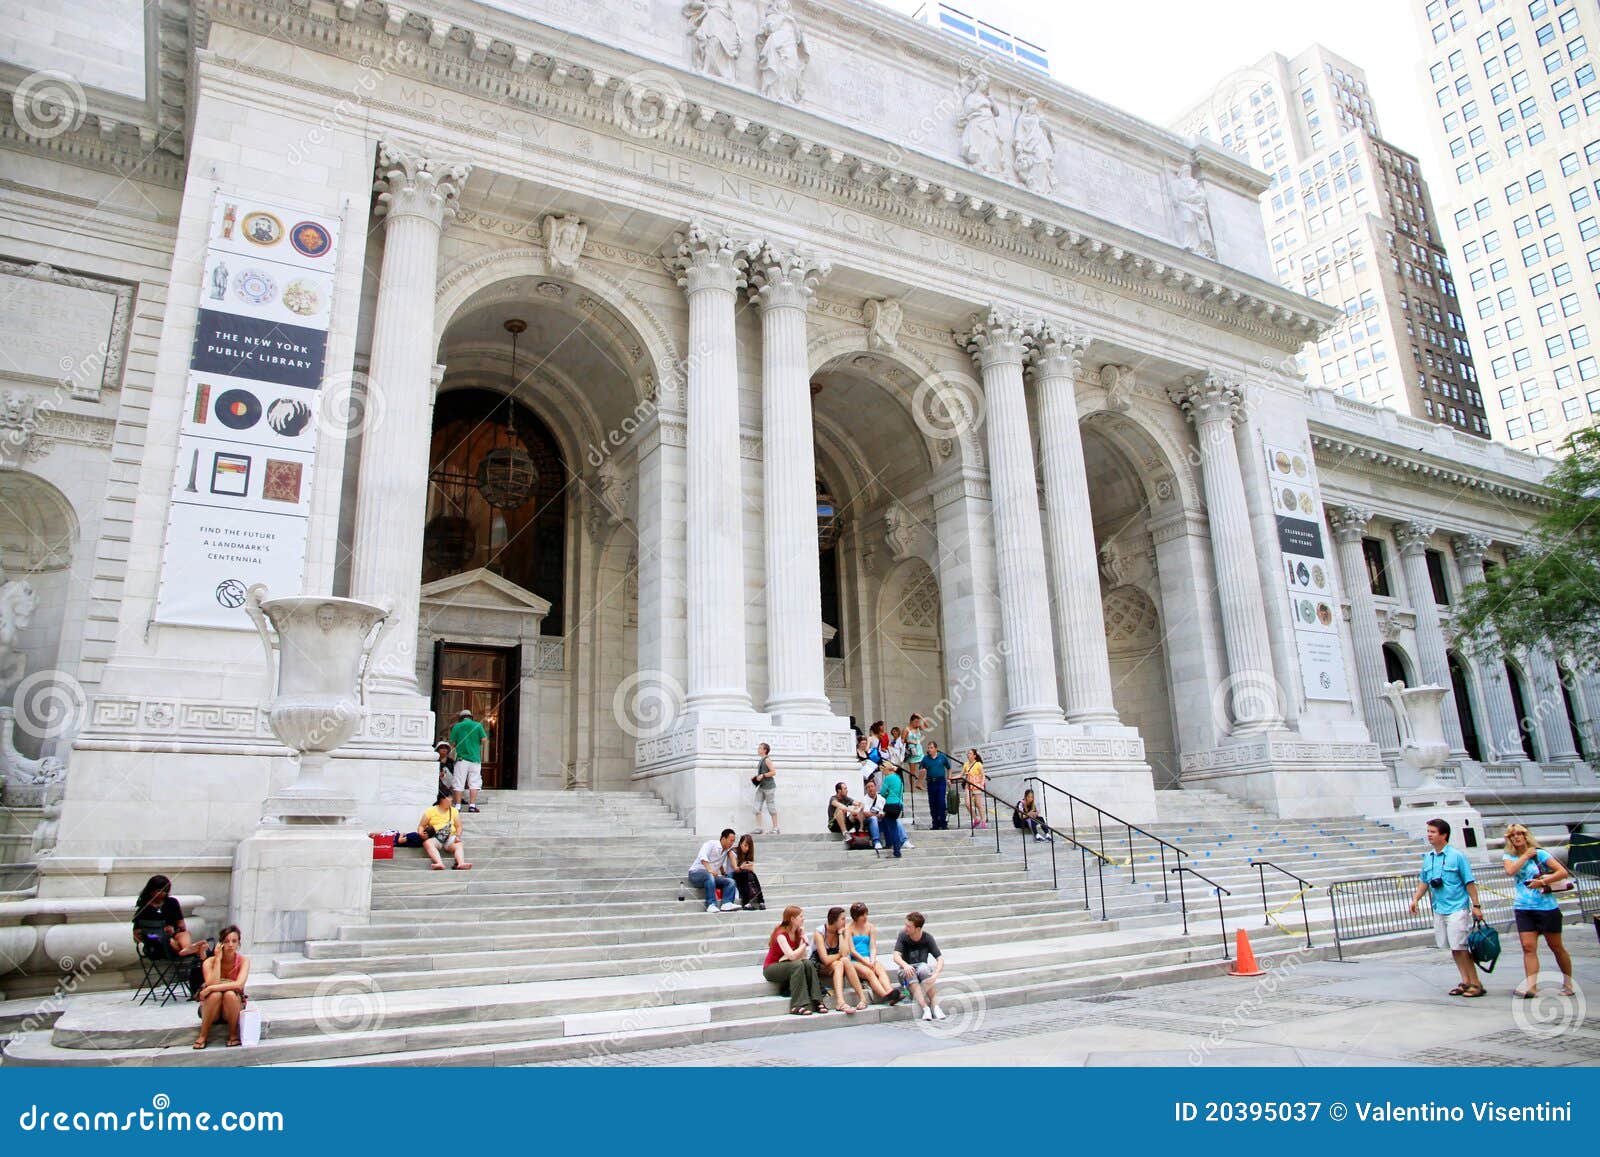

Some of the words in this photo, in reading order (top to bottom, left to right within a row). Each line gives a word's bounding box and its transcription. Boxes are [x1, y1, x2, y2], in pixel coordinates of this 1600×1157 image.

[621, 143, 695, 187] THE
[720, 174, 797, 213] NEW
[823, 204, 898, 247] YORK
[919, 234, 1009, 279] PUBLIC
[1029, 269, 1121, 315] LIBRARY
[215, 331, 239, 342] THE
[244, 336, 271, 347] NEW
[277, 341, 308, 354] YORK
[207, 345, 253, 360] PUBLIC
[259, 354, 312, 369] LIBRARY
[200, 526, 221, 534] FIND
[243, 531, 276, 540] FUTURE
[212, 541, 271, 552] LANDMARK'S
[207, 553, 262, 564] CENTENNIAL
